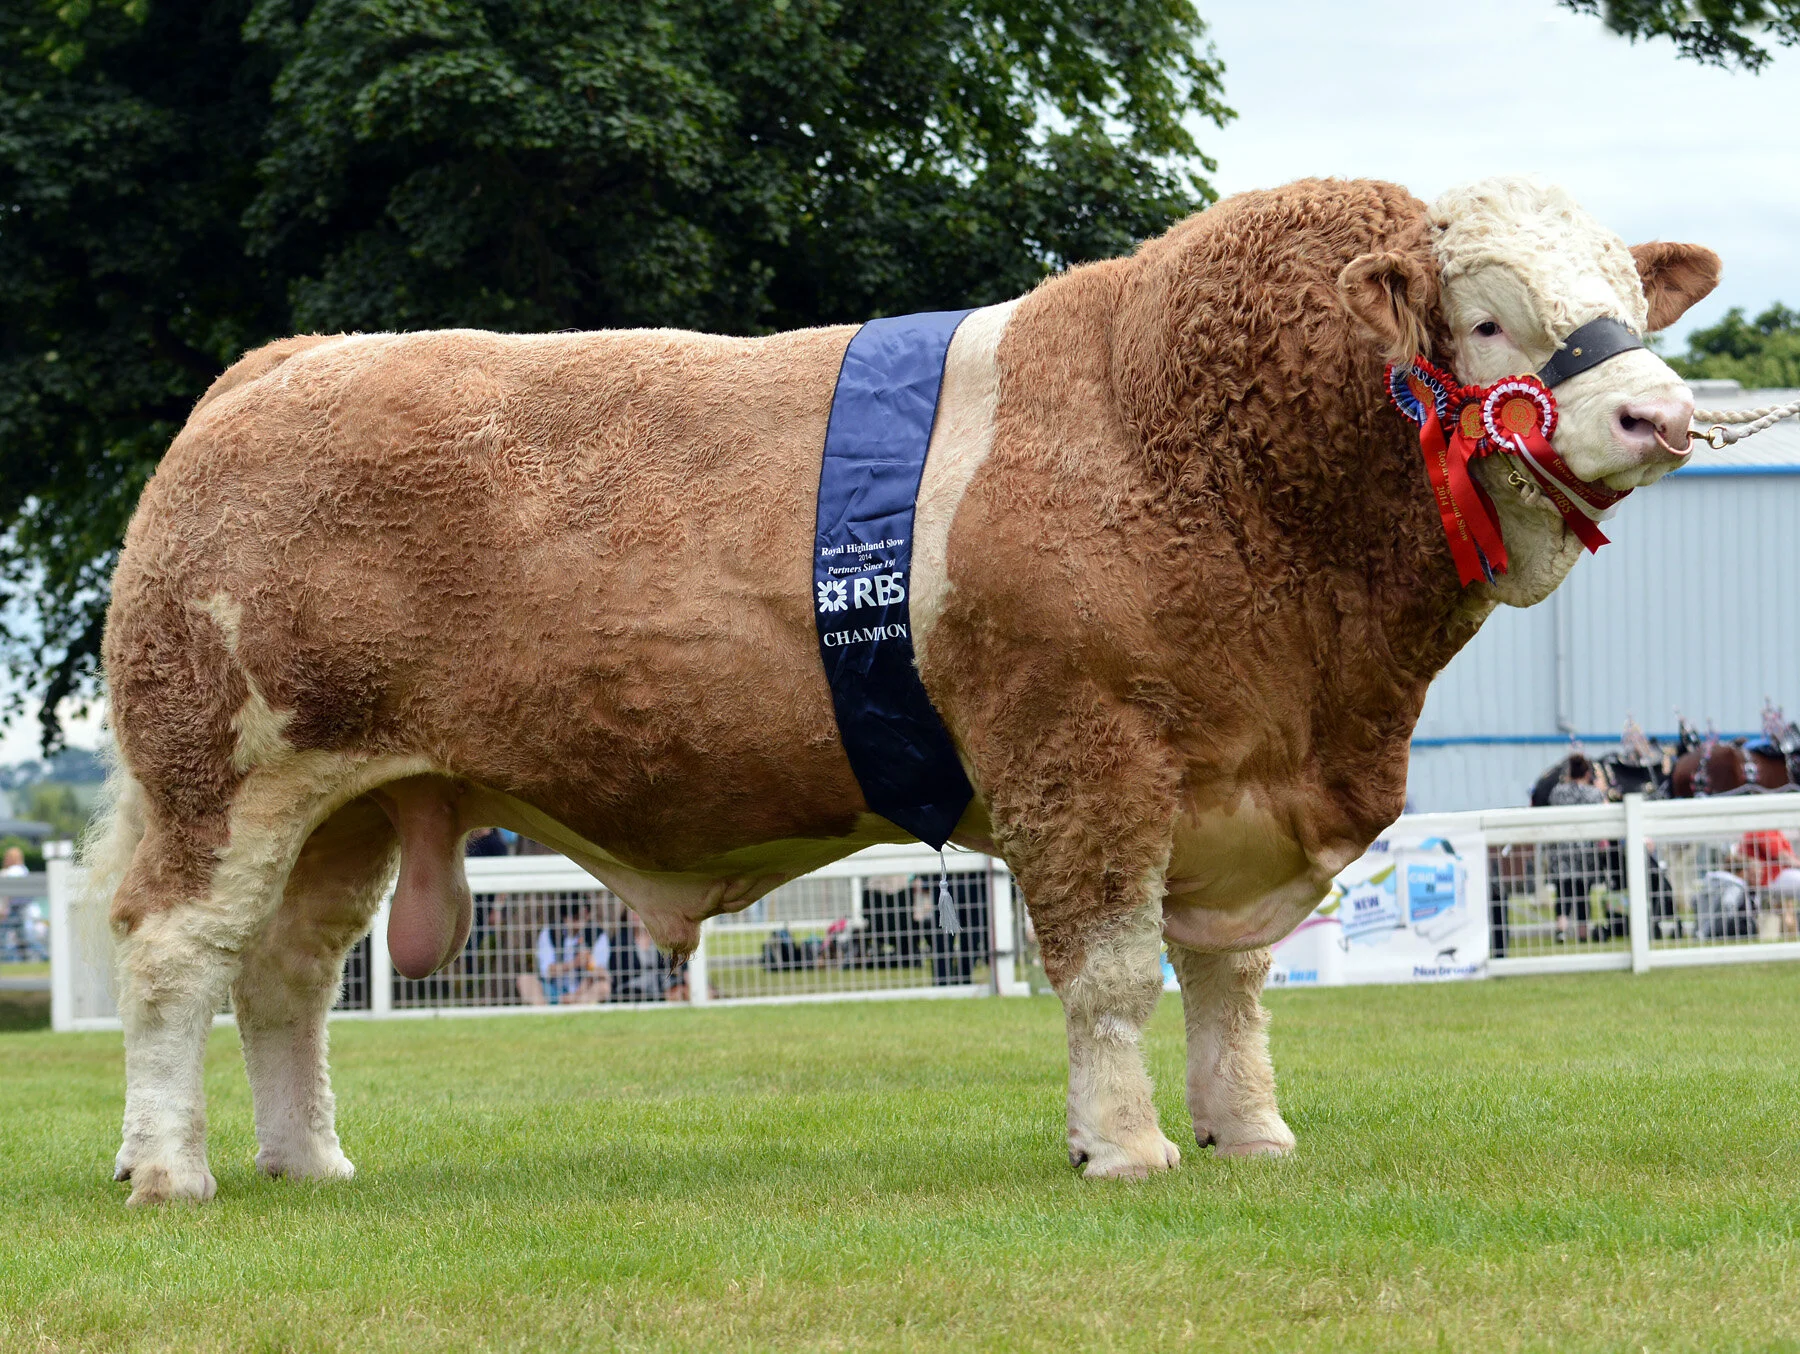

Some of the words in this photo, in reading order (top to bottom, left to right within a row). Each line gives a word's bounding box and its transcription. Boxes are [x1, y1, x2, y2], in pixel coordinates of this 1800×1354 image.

[1552, 458, 1574, 480] Royal
[1436, 486, 1449, 506] 2014
[1553, 492, 1573, 514] RBS
[1457, 519, 1468, 541] Show
[821, 545, 844, 557] Royal
[846, 540, 885, 554] Highland
[858, 553, 873, 562] 2014
[828, 565, 862, 575] Partners
[863, 562, 883, 572] Since
[854, 572, 906, 609] RBS
